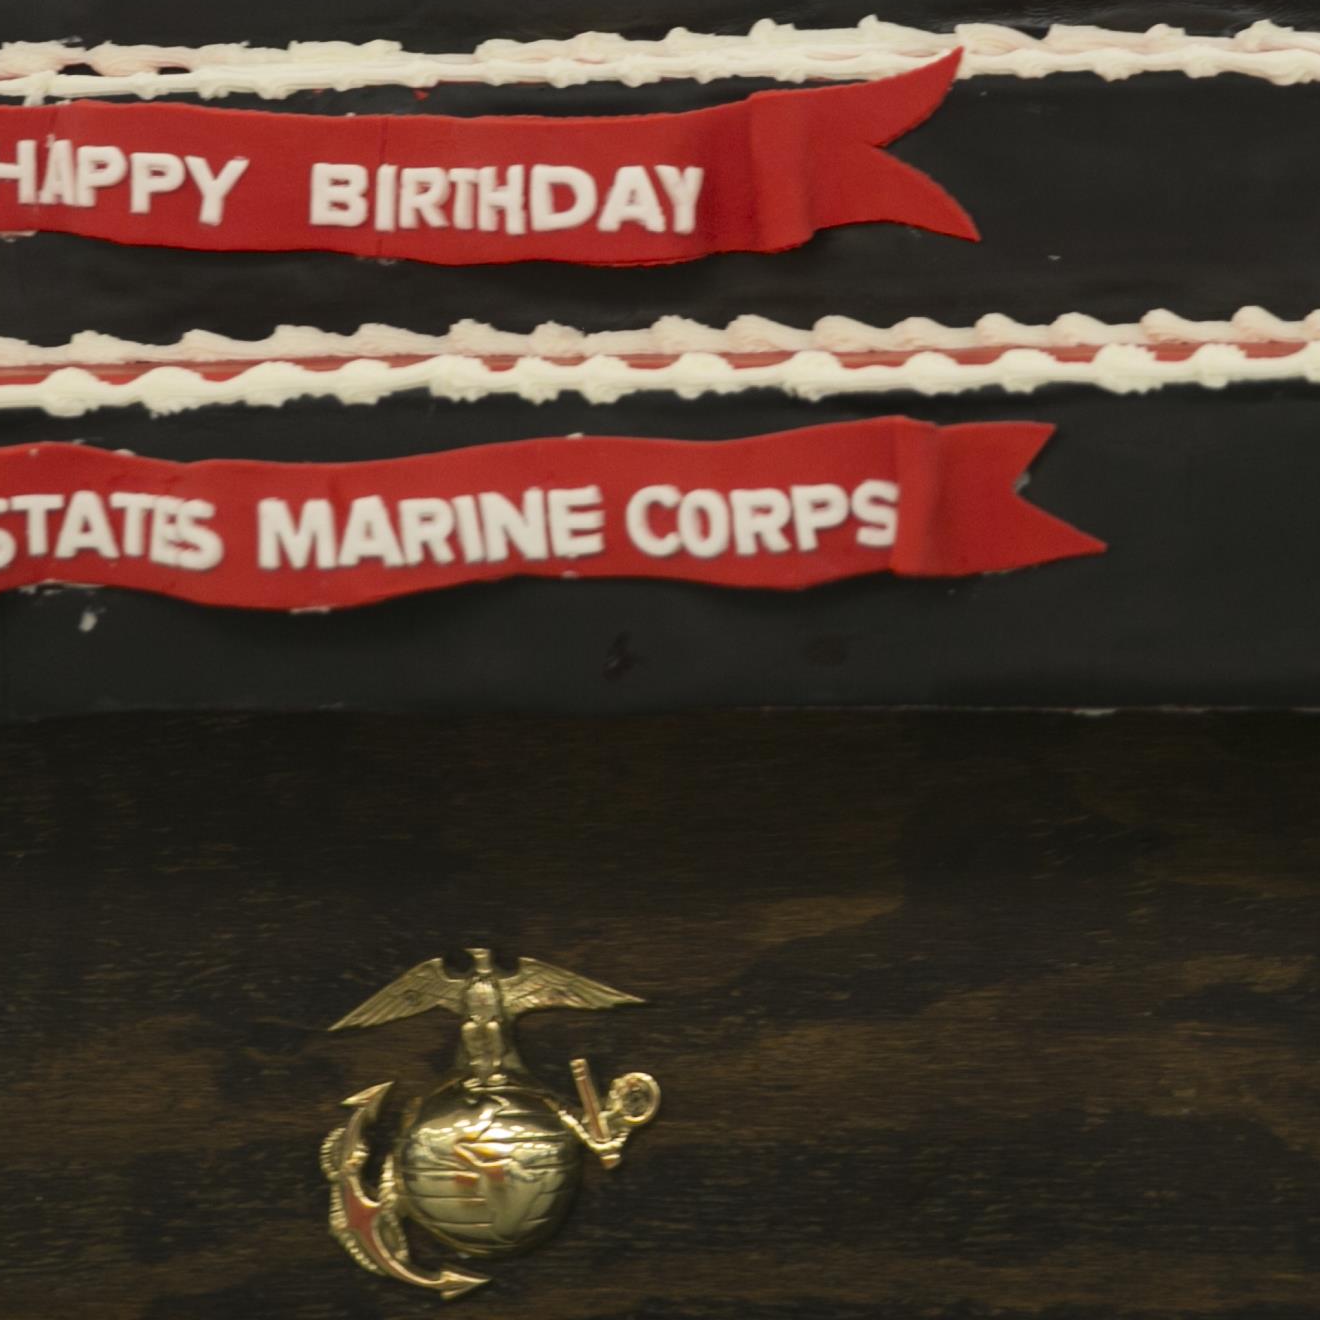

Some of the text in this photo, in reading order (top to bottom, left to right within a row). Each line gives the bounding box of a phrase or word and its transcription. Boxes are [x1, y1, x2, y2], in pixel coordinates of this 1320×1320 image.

[309, 162, 705, 236] BIRTHDAY
[257, 484, 605, 570] MARINE
[625, 479, 900, 560] CORPS
